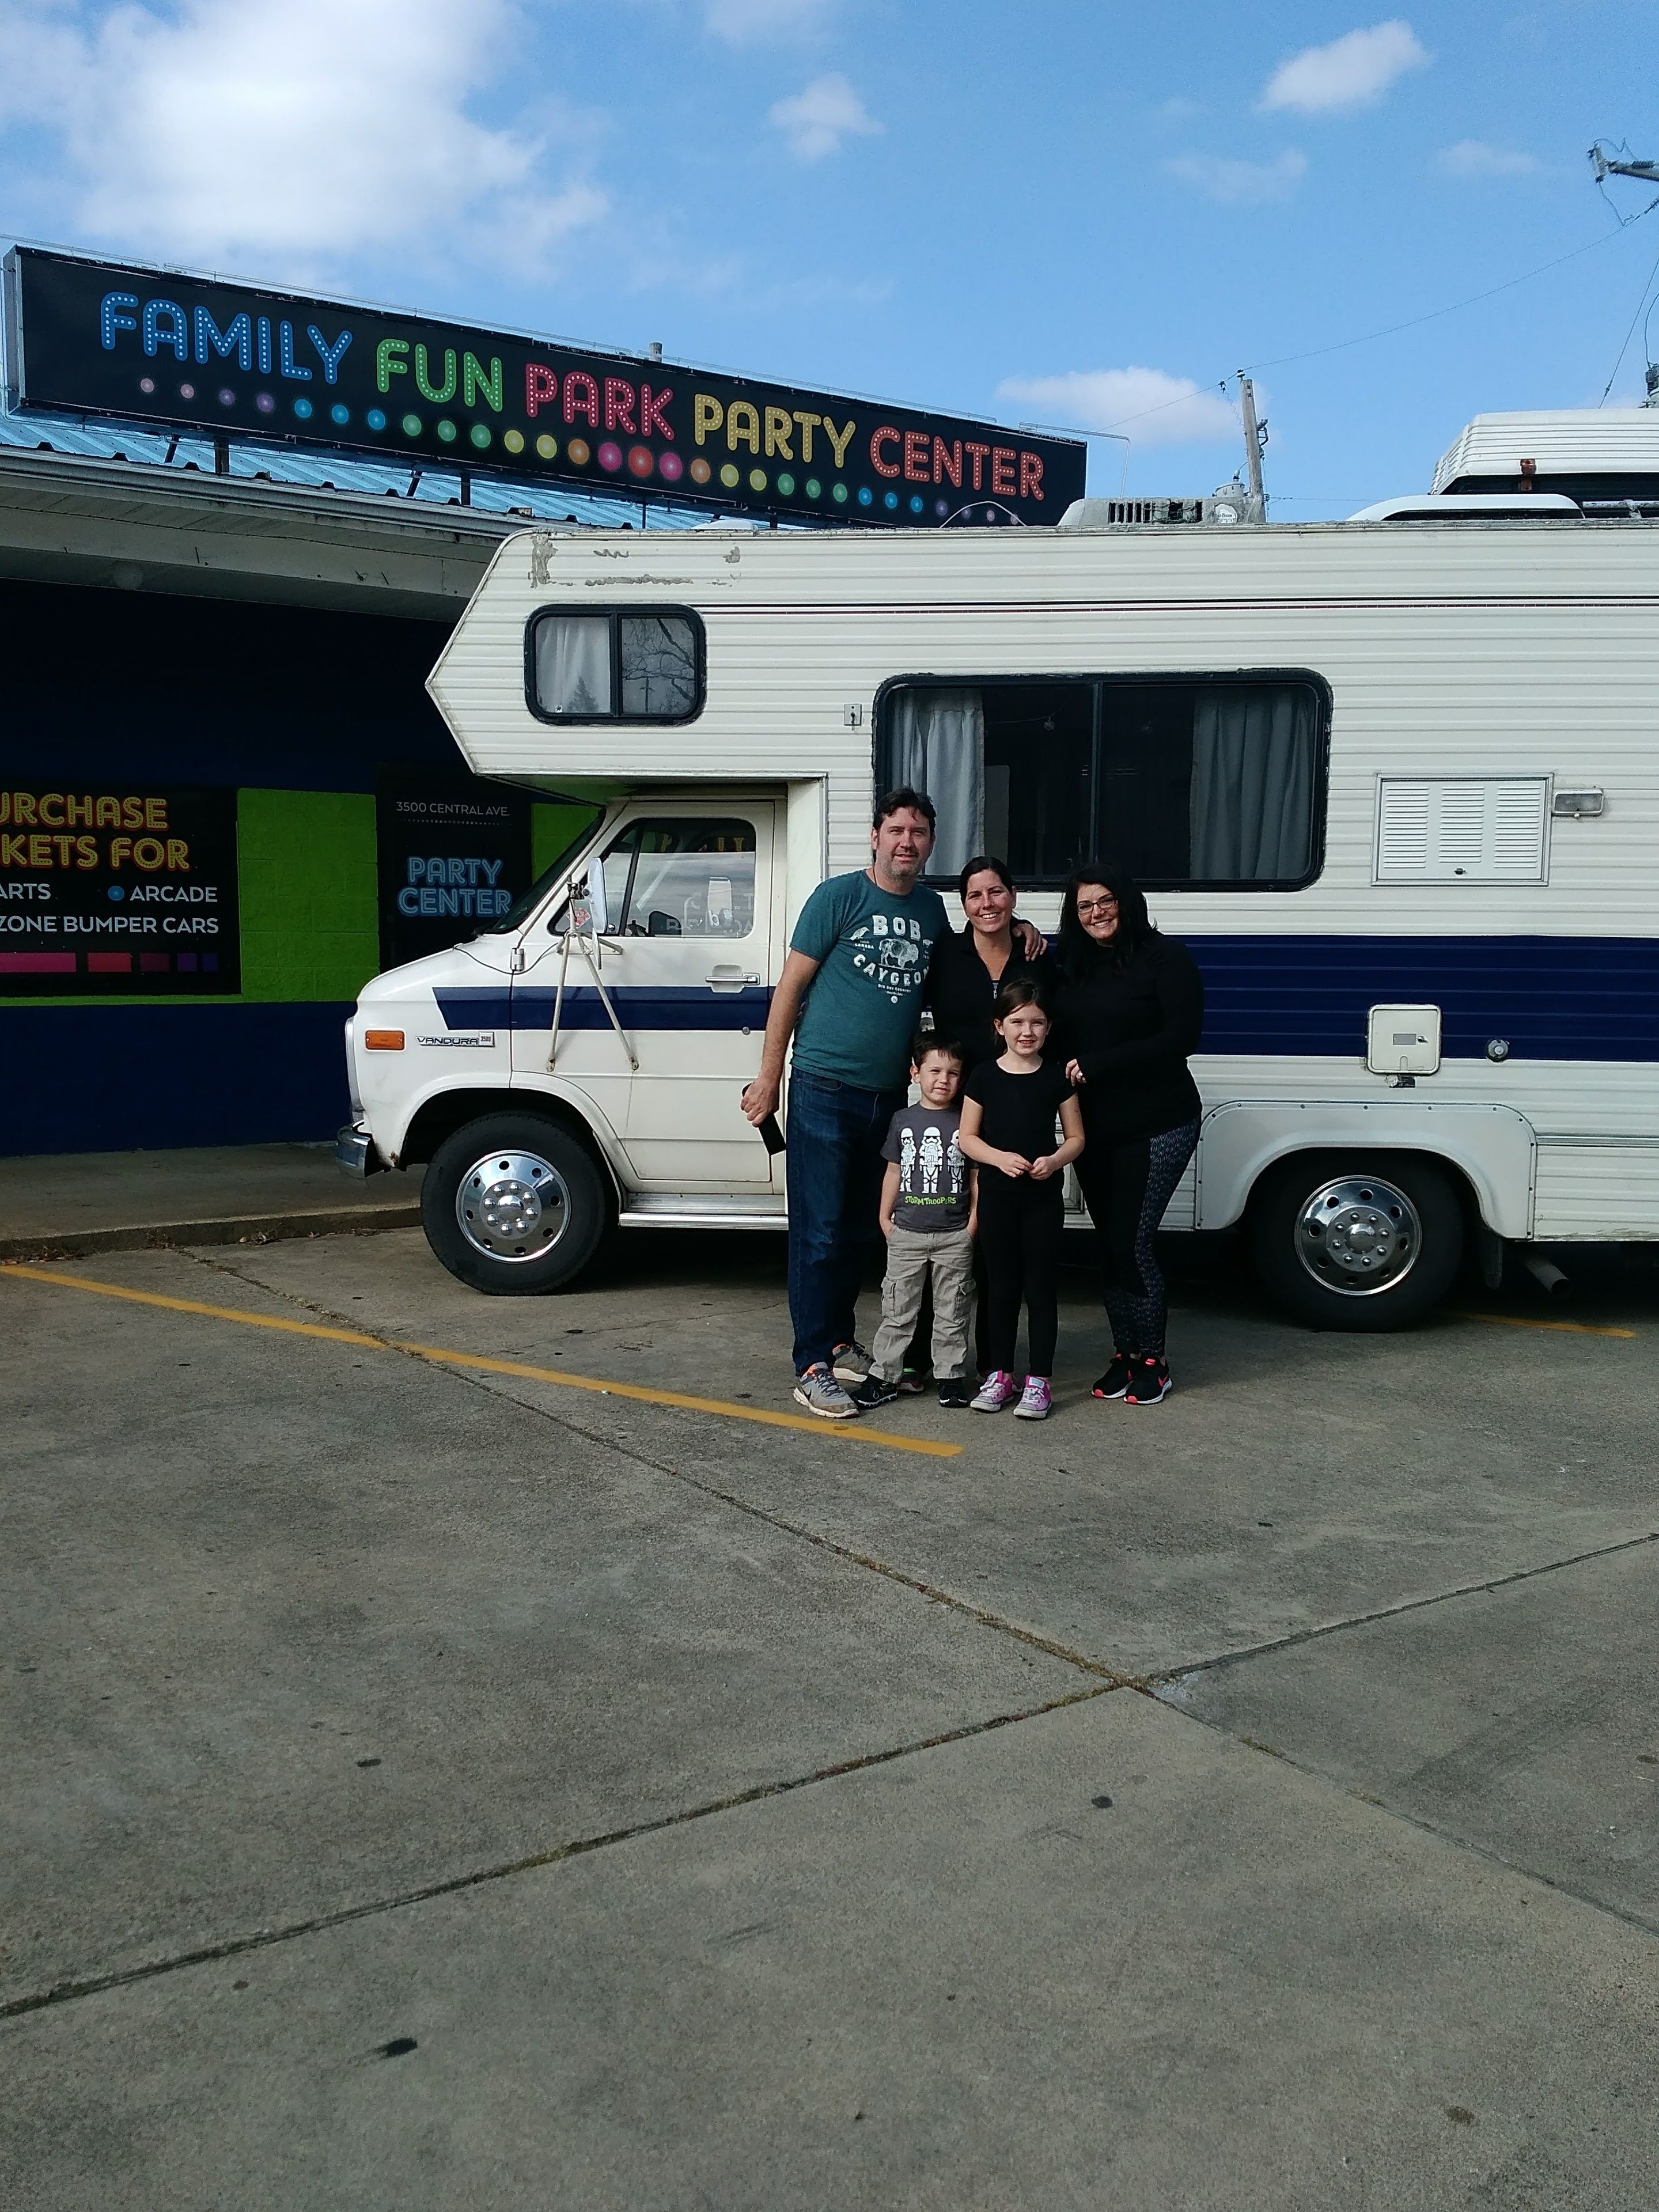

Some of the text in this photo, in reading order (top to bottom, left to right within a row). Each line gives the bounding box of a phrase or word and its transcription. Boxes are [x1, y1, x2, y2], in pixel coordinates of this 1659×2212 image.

[100, 291, 1044, 501] FAMILY FUN PARK PARTY CENTER
[396, 801, 510, 816] 3500 CENTRAL AVE.
[1, 834, 191, 871] KETS FOR
[408, 857, 503, 886] PARTY
[130, 885, 218, 903] ARCADE
[398, 887, 513, 916] CENTER
[64, 916, 157, 933] BUMPER
[162, 917, 219, 934] CARS
[872, 915, 921, 941] BOB
